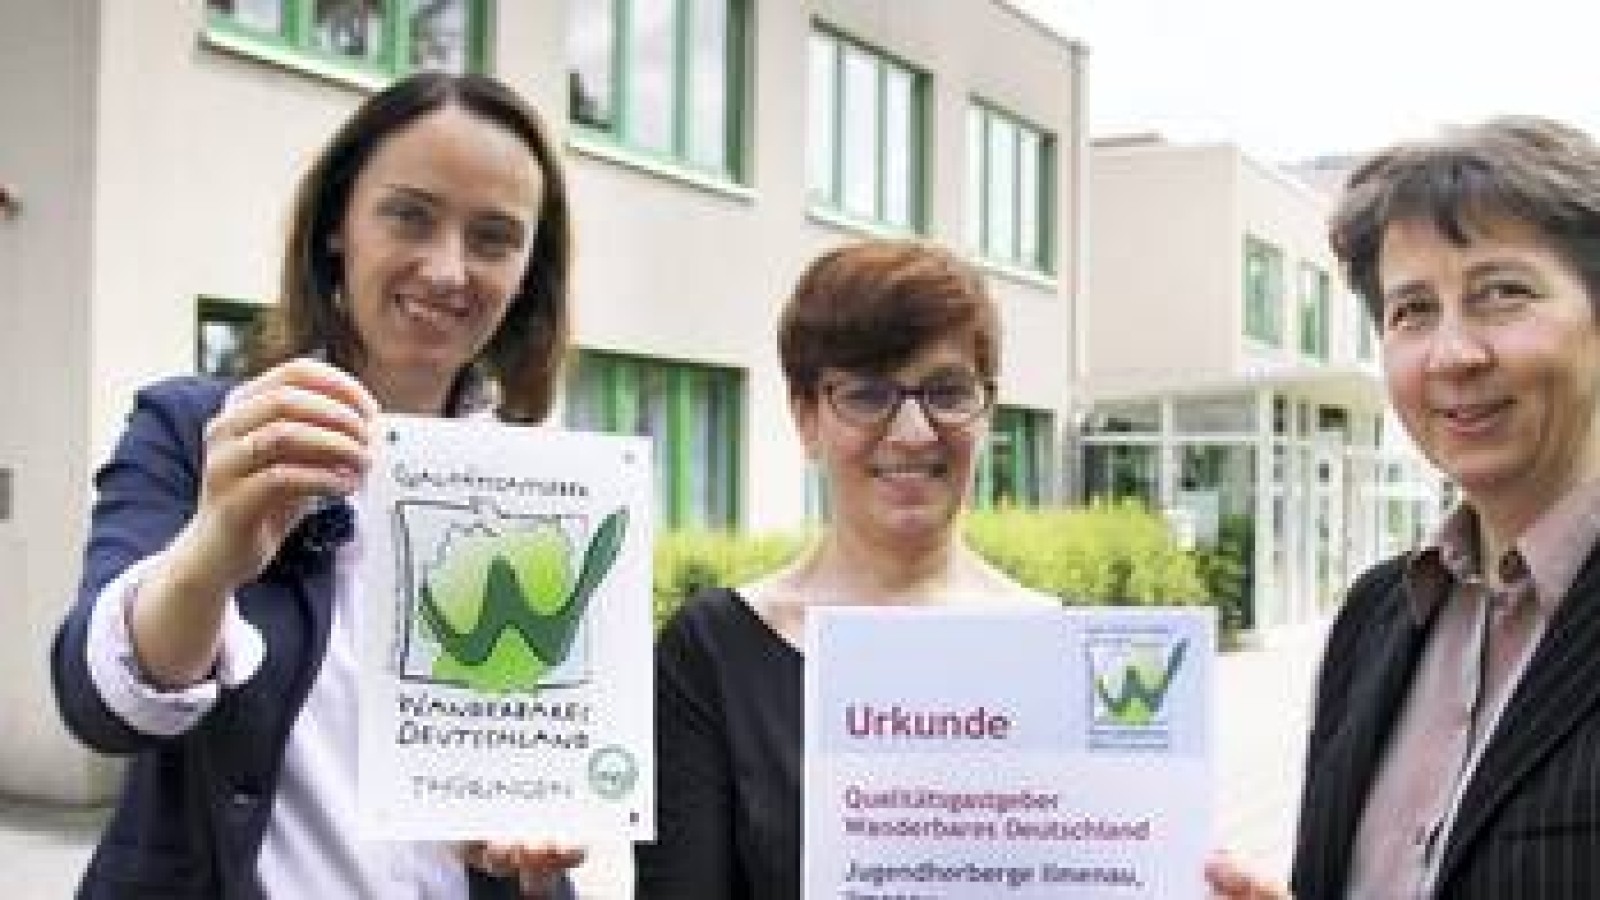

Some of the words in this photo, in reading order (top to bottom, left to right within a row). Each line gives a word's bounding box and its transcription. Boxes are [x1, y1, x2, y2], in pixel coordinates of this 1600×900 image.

[845, 705, 1011, 740] Urkunde
[845, 816, 996, 839] Wanderbares
[1005, 817, 1151, 841] Deutschland
